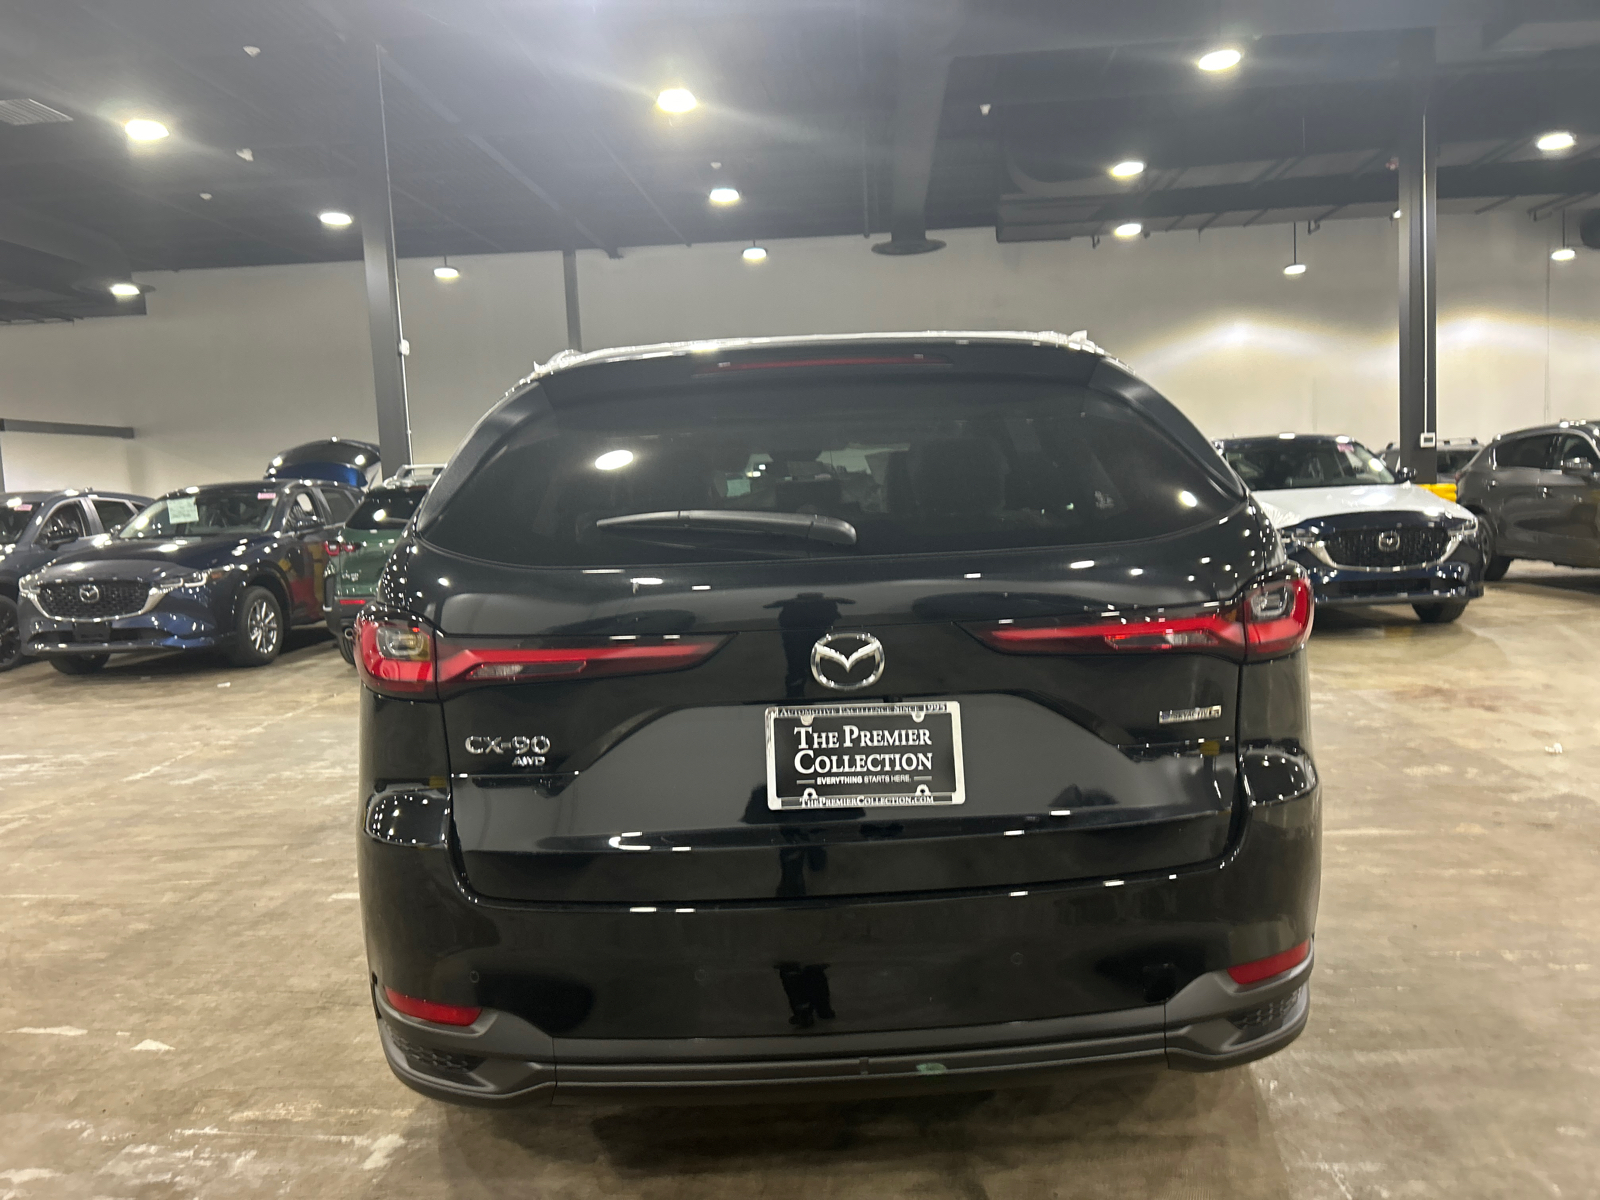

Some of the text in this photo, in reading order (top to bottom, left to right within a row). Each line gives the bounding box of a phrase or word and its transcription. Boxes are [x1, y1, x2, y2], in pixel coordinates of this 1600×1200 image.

[465, 735, 551, 754] CX-90
[794, 725, 932, 749] THE PREMIER
[512, 756, 546, 767] AWD
[794, 750, 933, 774] COLLECTION
[817, 776, 863, 785] EVERYTHING
[864, 775, 890, 784] STARTS
